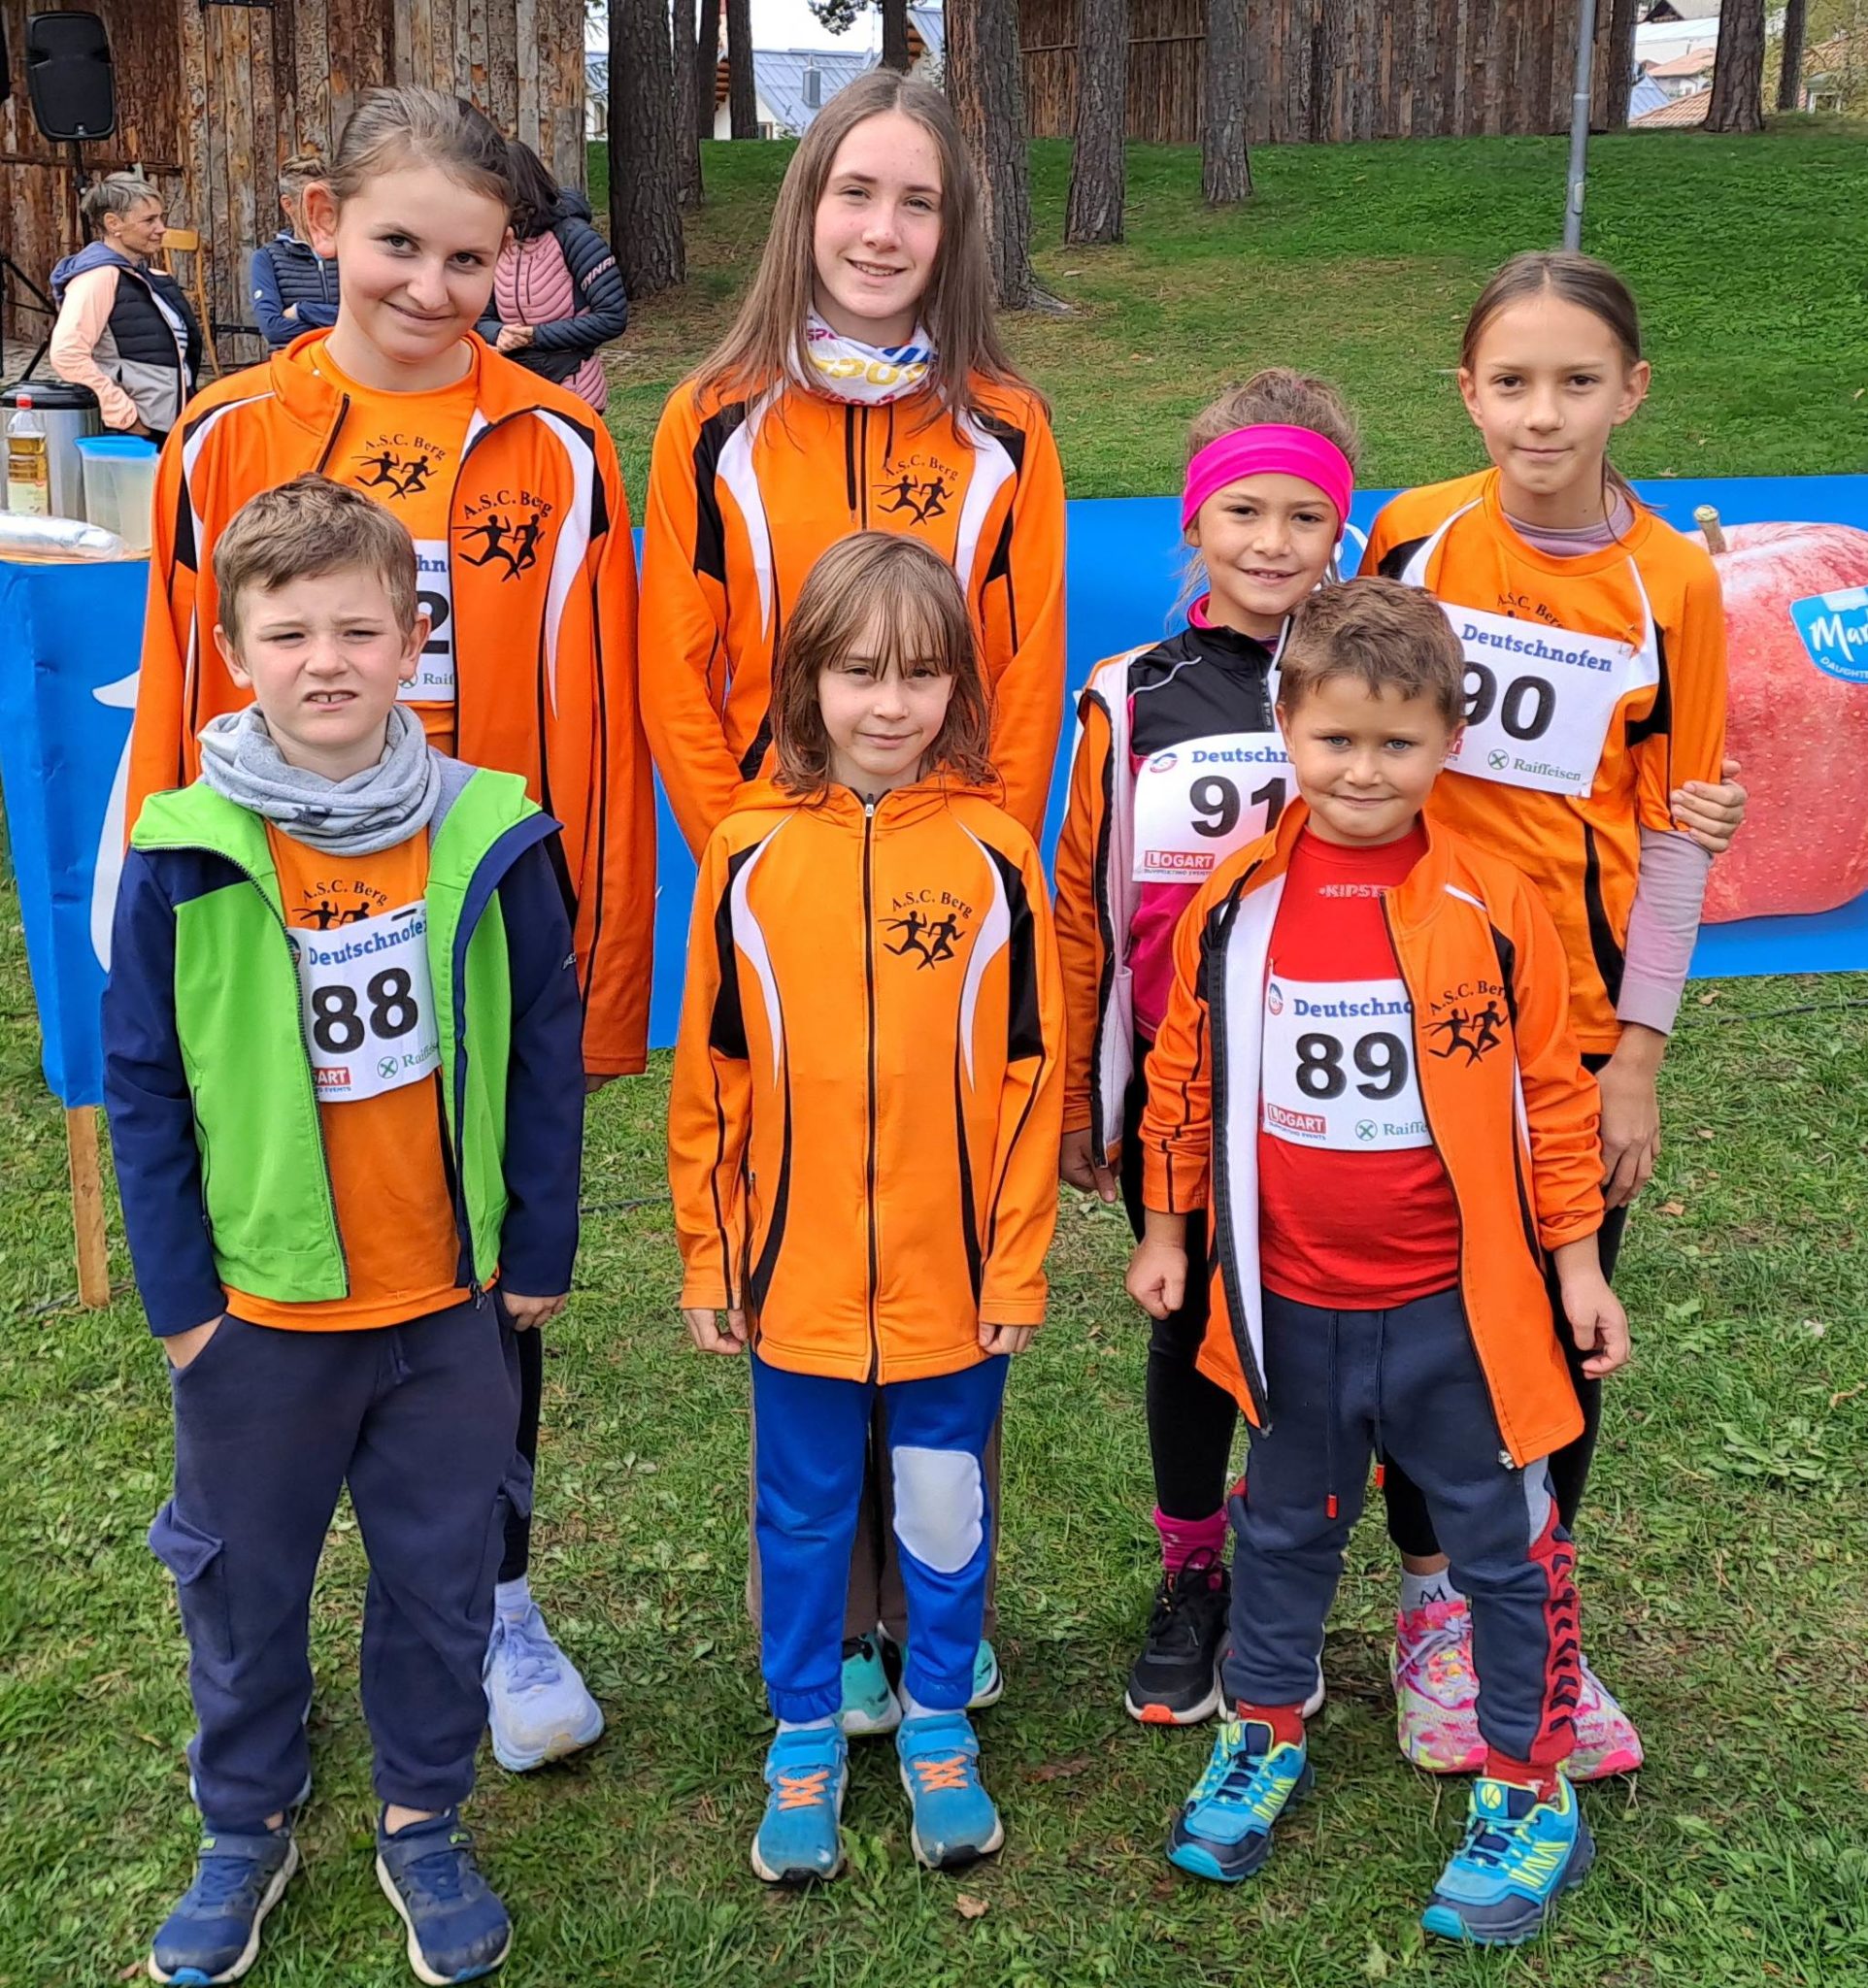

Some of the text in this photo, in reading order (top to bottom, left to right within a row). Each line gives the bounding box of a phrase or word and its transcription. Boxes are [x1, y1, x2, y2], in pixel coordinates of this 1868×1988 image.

[365, 433, 446, 461] A.S.C. Berg
[929, 455, 958, 481] Berg
[463, 489, 517, 519] A.S.C.
[1461, 623, 1613, 673] Deutschnofen
[1463, 660, 1556, 742] 90
[1513, 758, 1582, 782] Raiffeisen
[1189, 775, 1286, 839] 91
[1146, 851, 1214, 869] LOGART
[304, 879, 388, 907] A.S.C. Berg
[892, 889, 973, 919] A.S.C. Berg
[312, 967, 418, 1054] 88
[1429, 980, 1506, 1016] A.S.C. Ber
[314, 1069, 347, 1084] ART
[1296, 1032, 1408, 1100] 89
[1268, 1105, 1324, 1132] LOGART
